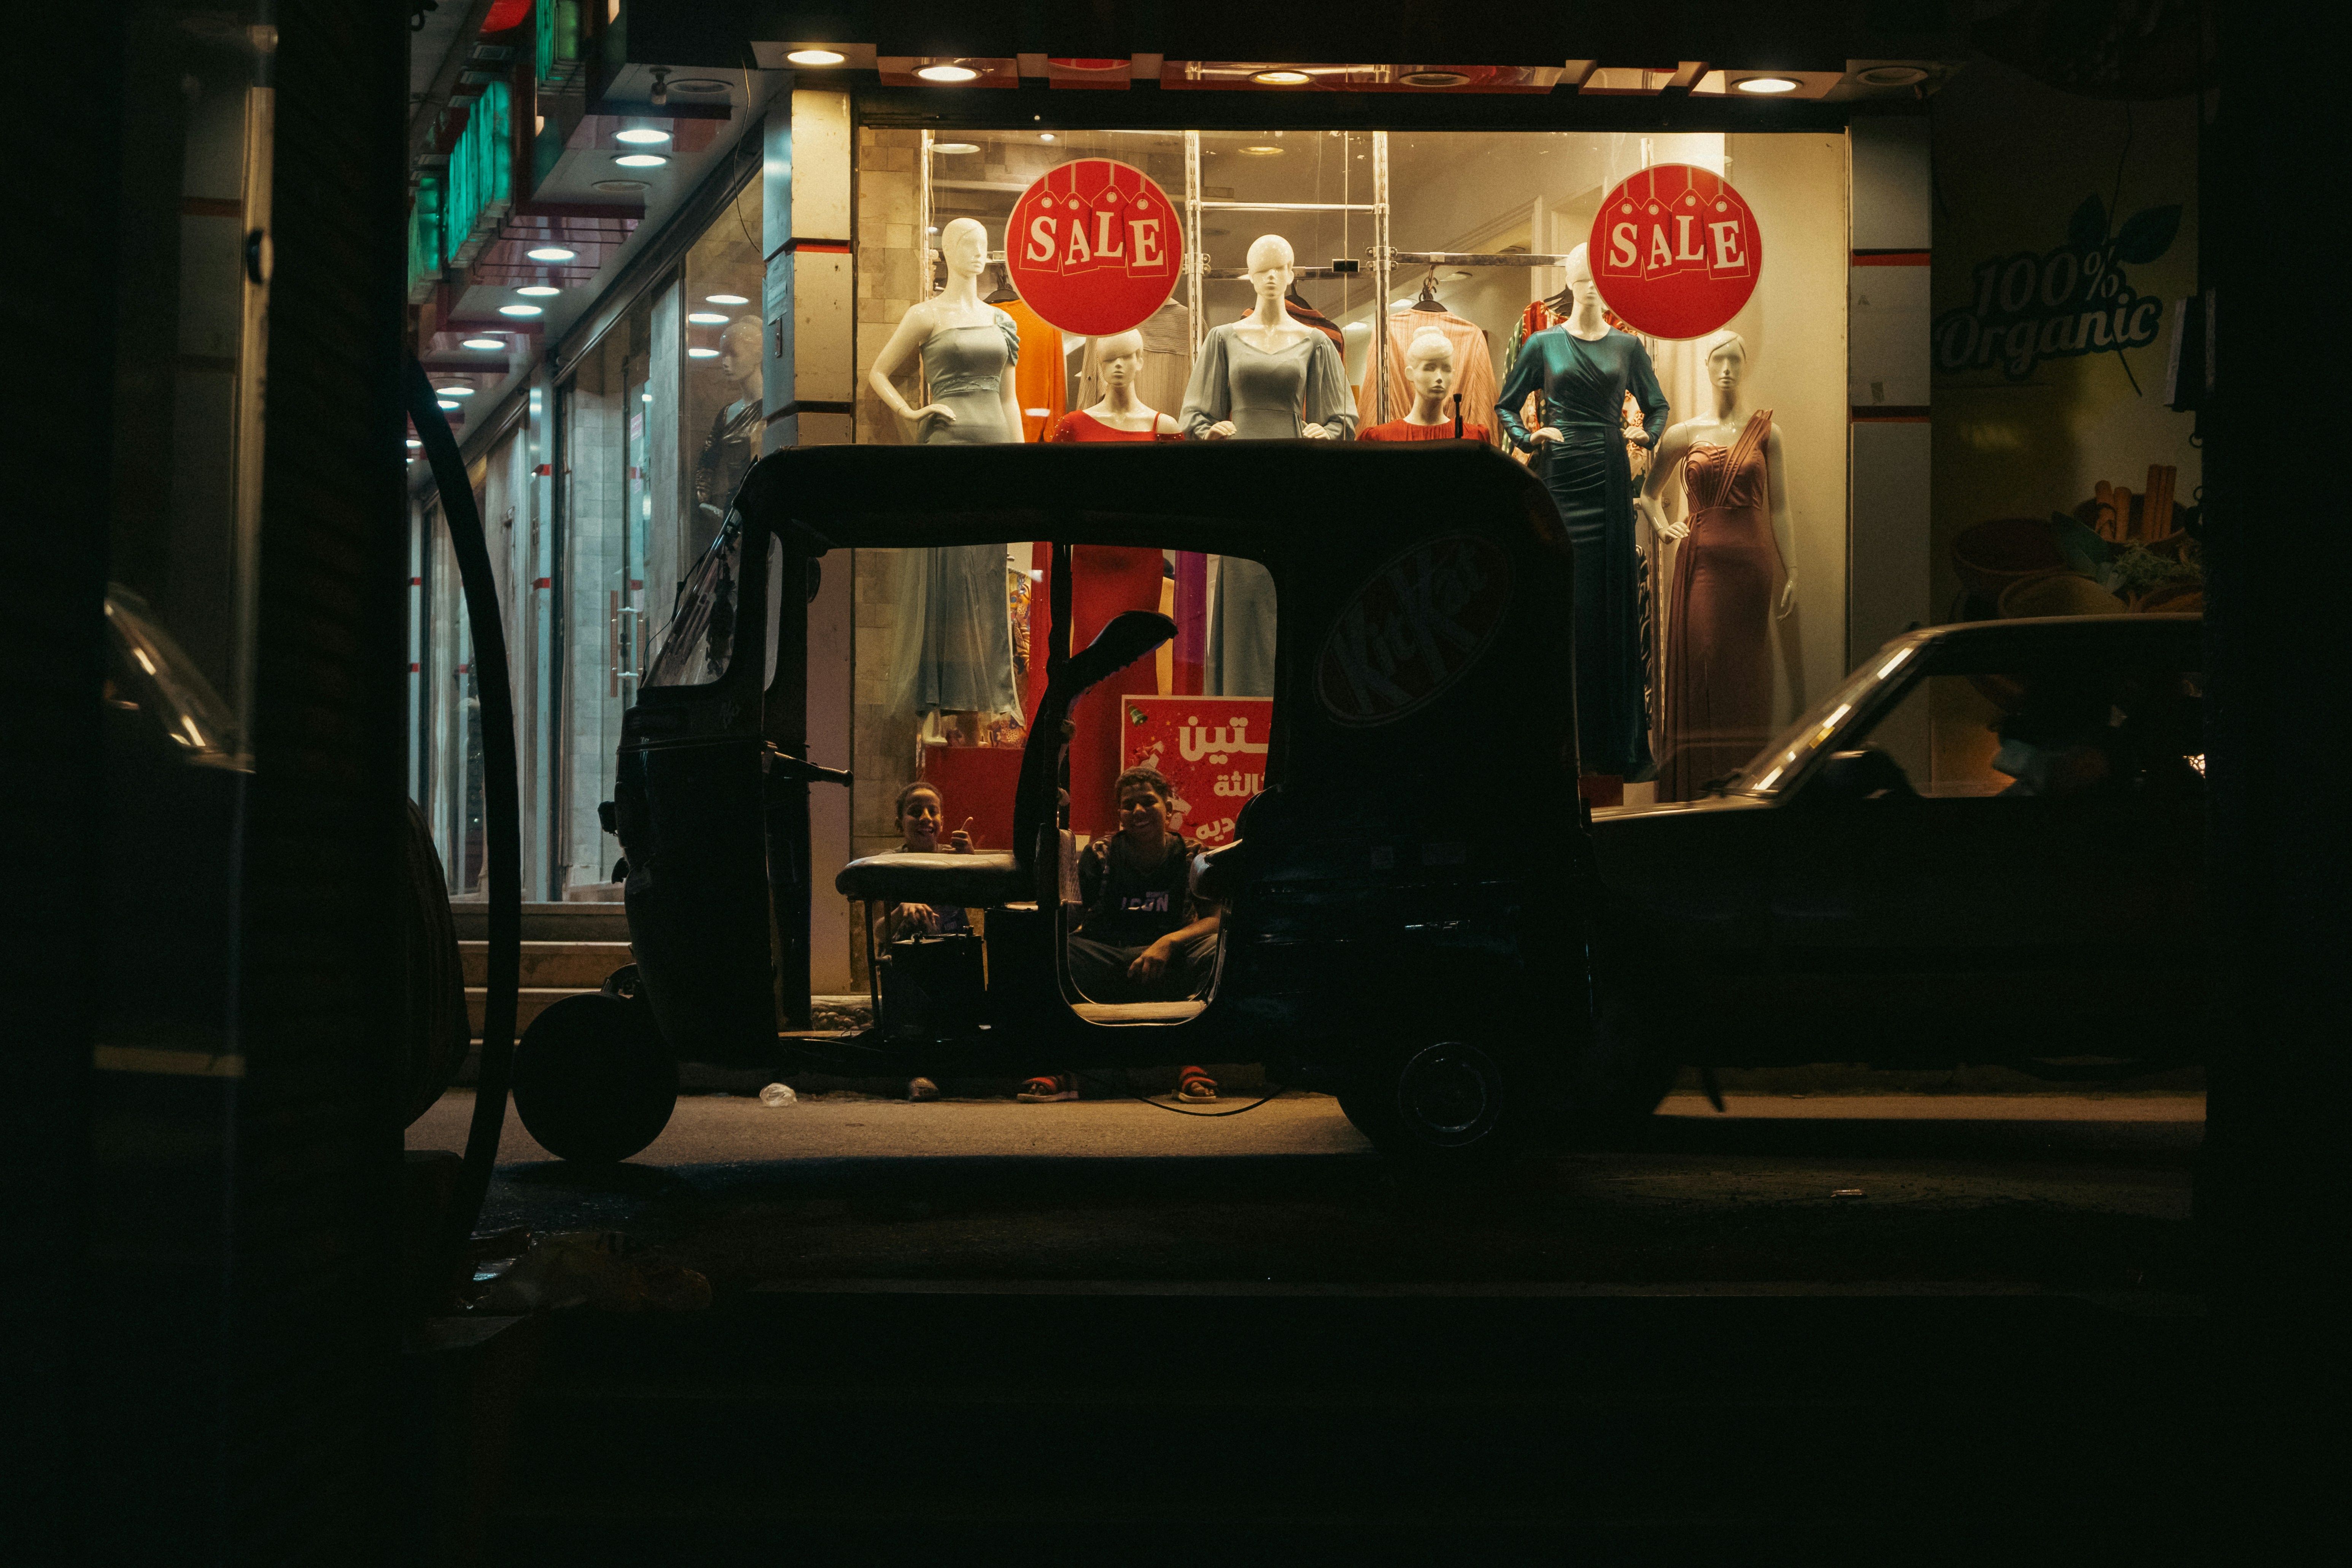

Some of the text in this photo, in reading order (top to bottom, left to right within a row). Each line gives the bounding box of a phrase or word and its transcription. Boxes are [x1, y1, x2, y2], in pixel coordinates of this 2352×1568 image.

[1027, 211, 1163, 267] SALE
[1609, 215, 1745, 270] SALE
[1977, 245, 2120, 316] 100%
[1939, 293, 2156, 375] Organic
[1331, 542, 1488, 715] KitKat
